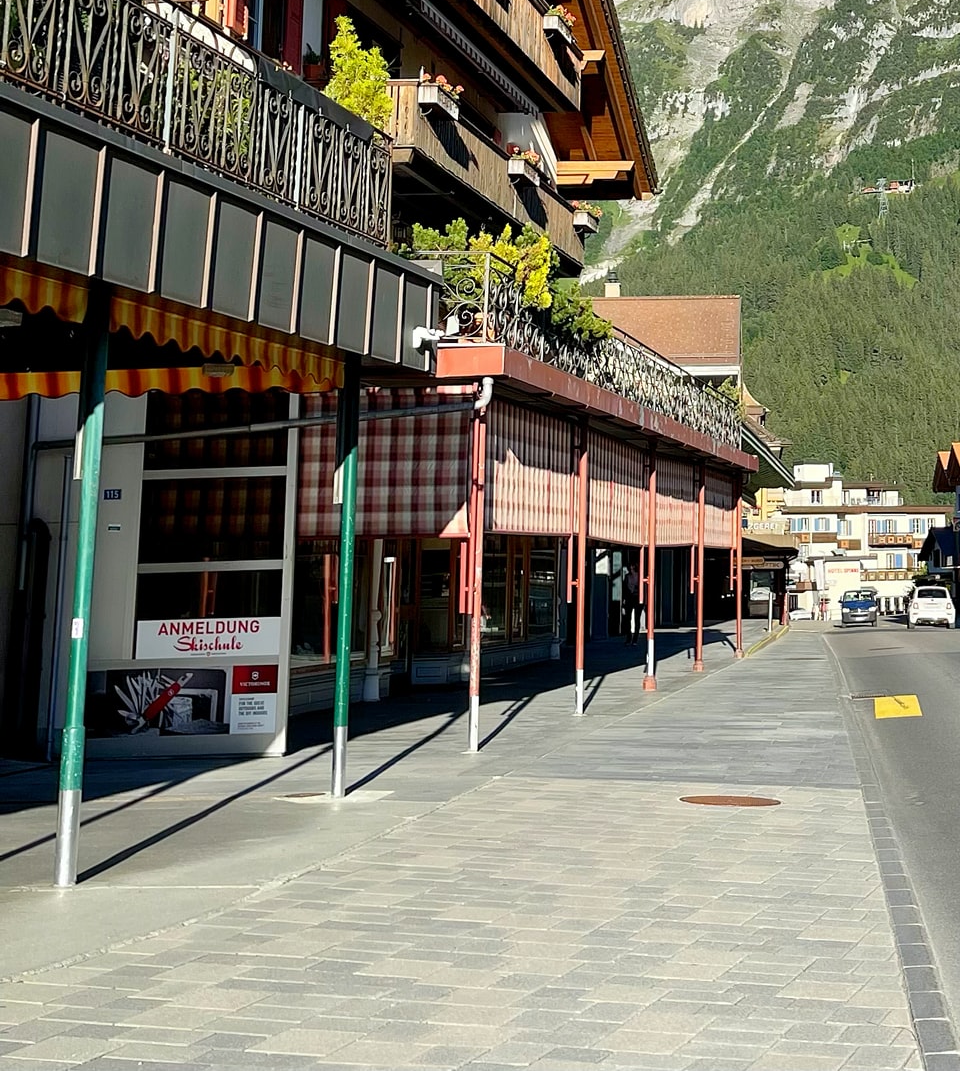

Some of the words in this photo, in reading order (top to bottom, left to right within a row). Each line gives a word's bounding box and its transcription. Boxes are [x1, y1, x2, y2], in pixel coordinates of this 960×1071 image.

[106, 490, 119, 499] 115
[158, 620, 260, 636] ANMELDUNG
[173, 635, 244, 652] Skischule
